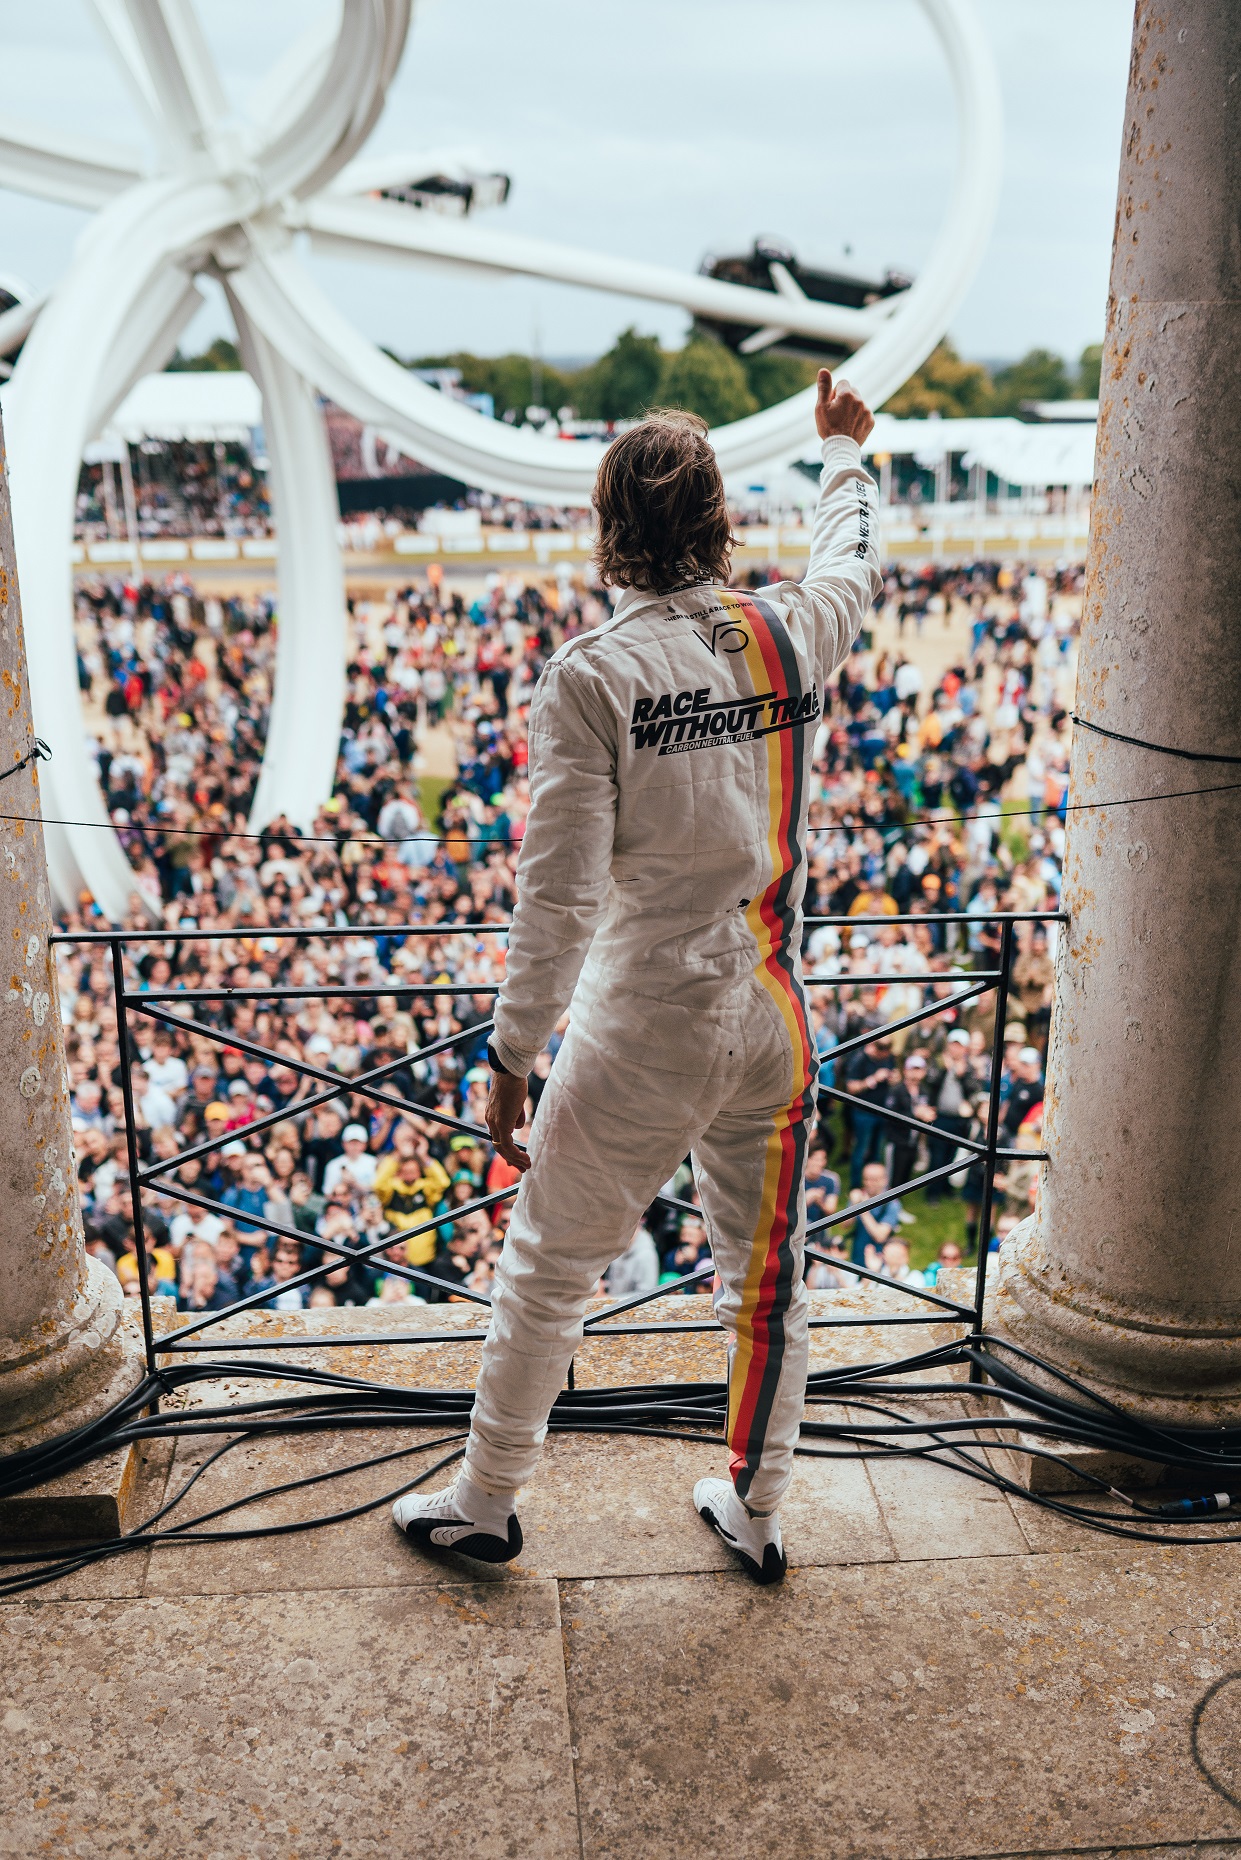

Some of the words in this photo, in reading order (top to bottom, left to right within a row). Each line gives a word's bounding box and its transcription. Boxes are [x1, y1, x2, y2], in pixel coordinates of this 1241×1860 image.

[858, 500, 869, 540] NEUTRL
[689, 609, 708, 620] STILL
[632, 688, 711, 724] RACE
[630, 703, 765, 750] WITHOUT
[666, 741, 701, 754] CARBON
[701, 736, 735, 748] NEUTRAL
[735, 732, 754, 742] FUEL
